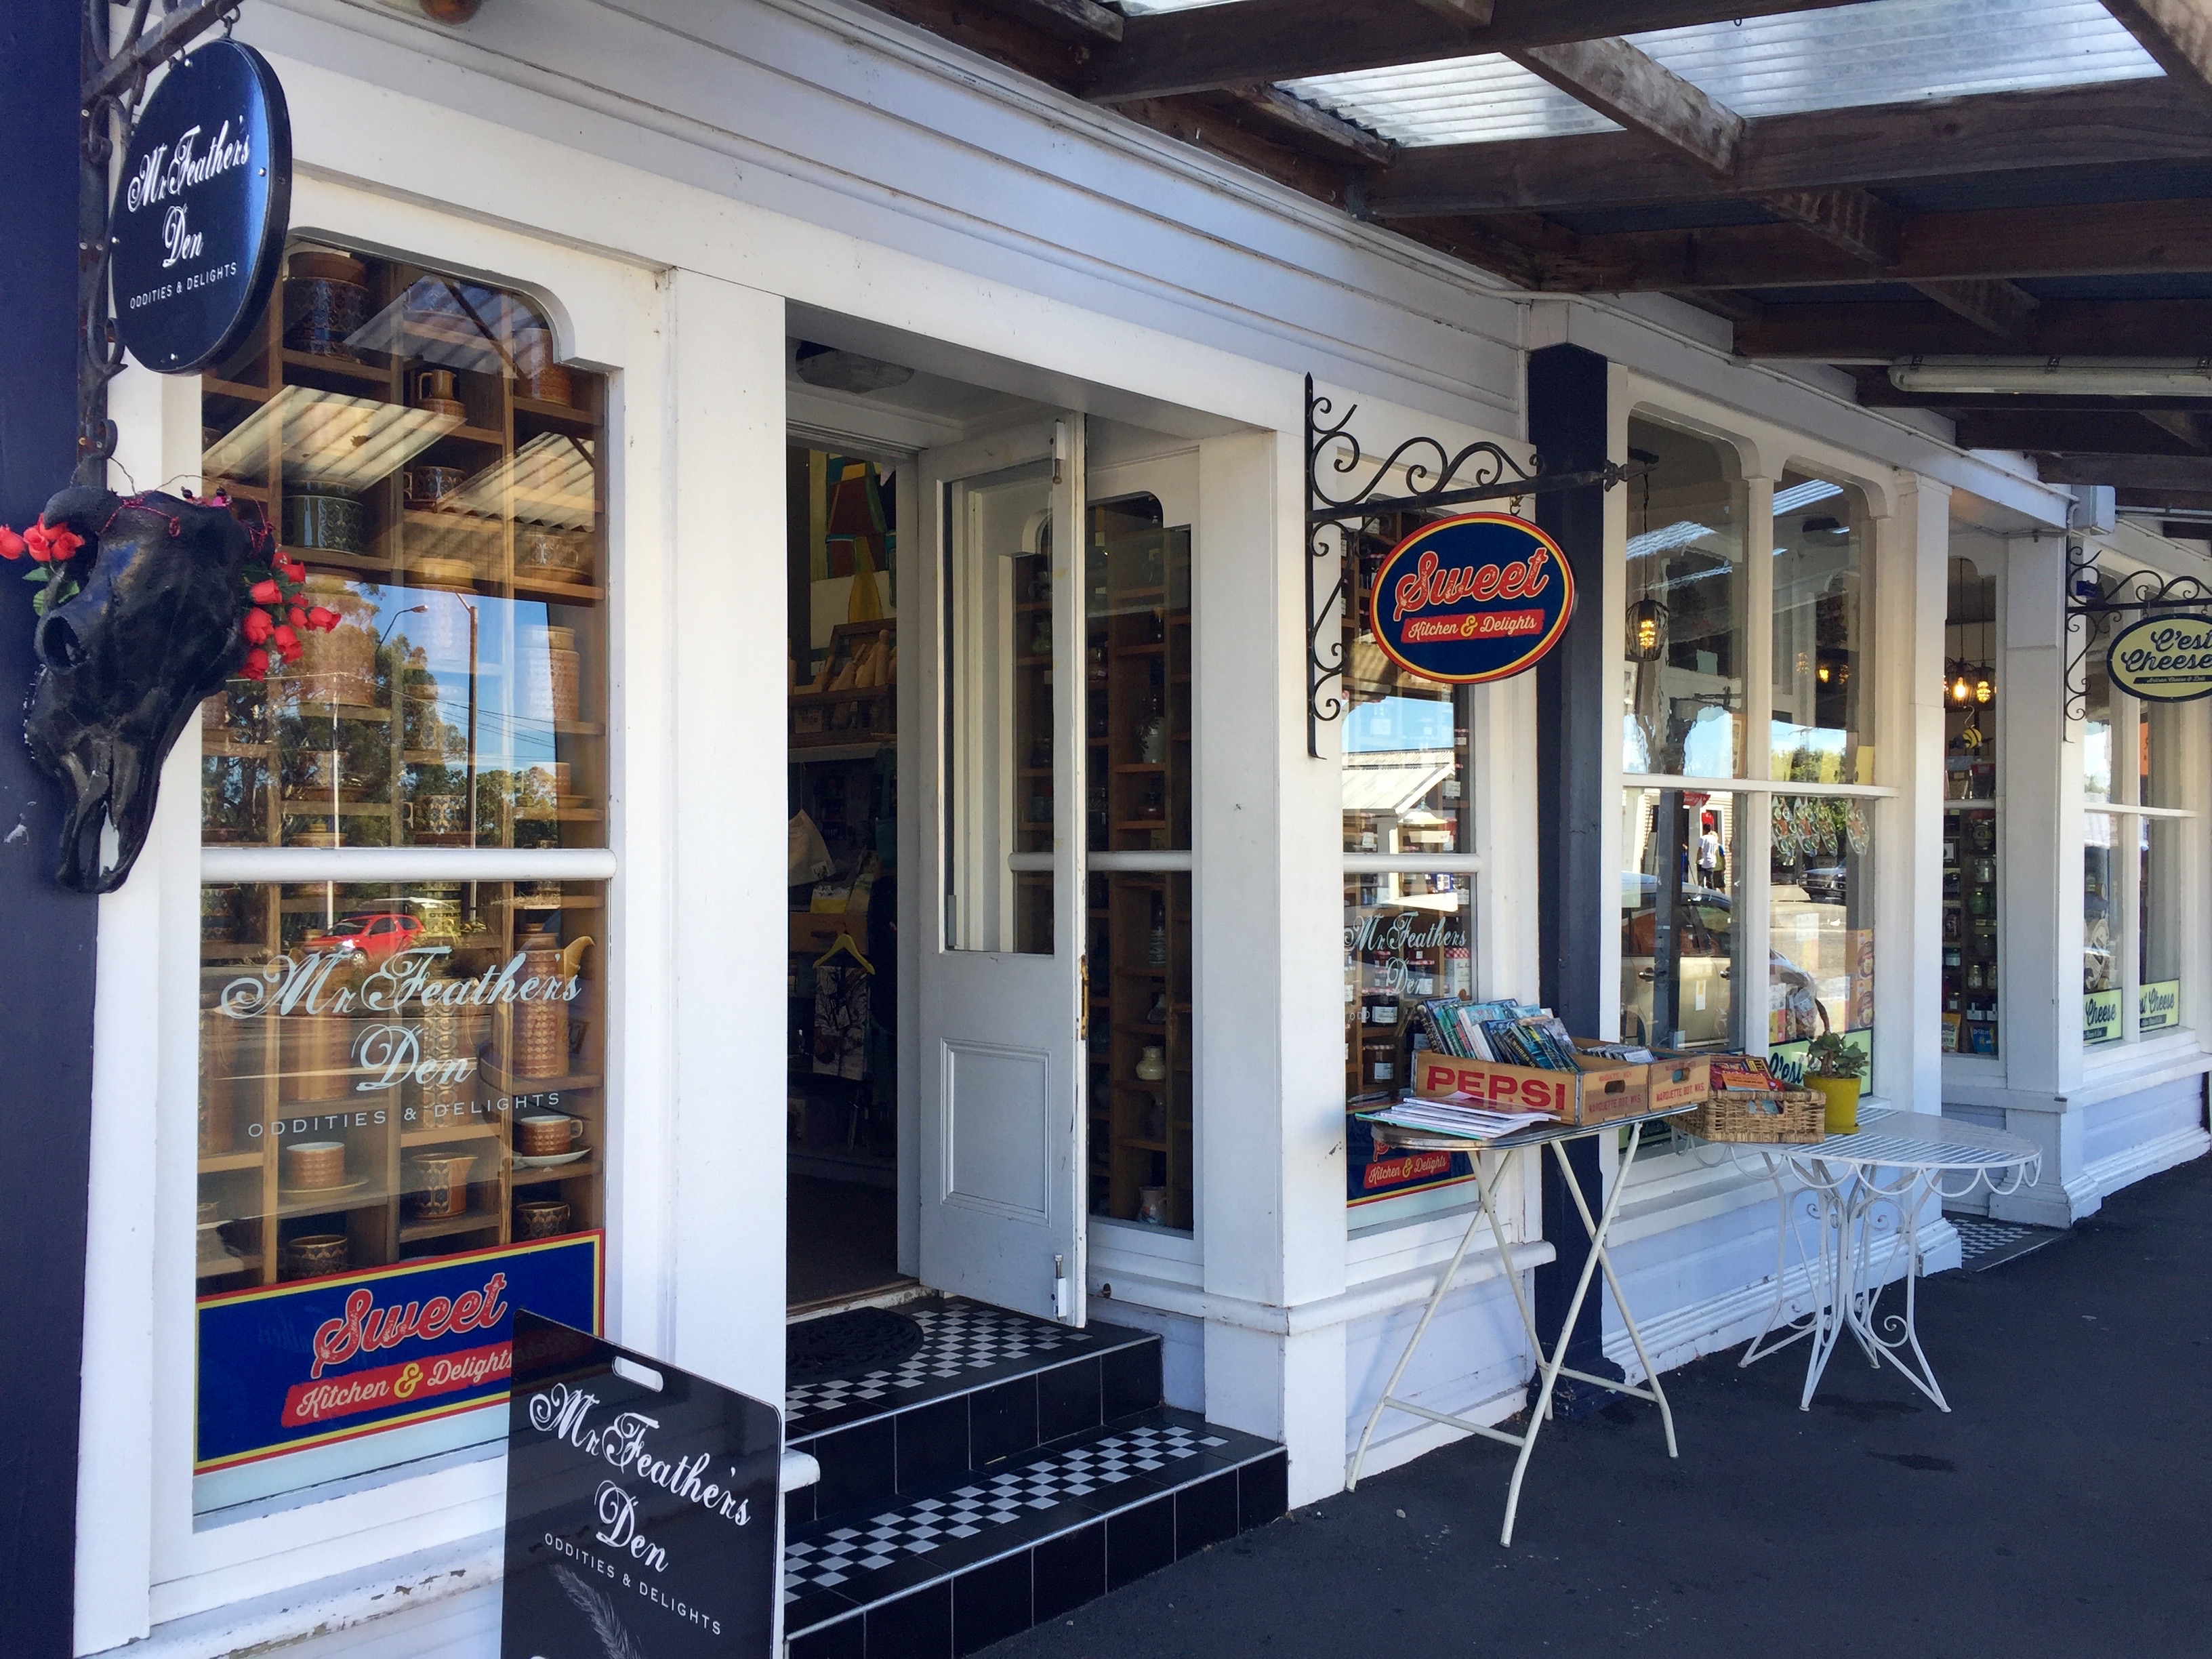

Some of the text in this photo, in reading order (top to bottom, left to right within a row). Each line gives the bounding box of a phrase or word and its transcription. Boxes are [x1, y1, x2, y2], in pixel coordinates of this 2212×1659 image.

[127, 115, 250, 213] Mr Feather's
[162, 205, 203, 268] Den
[129, 262, 237, 310] ODDITIES & DELIGHTS
[1393, 547, 1549, 621] Sweet
[1408, 615, 1537, 640] Kitchen & Delights
[2150, 628, 2212, 652] C'est
[2121, 649, 2212, 673] Cheese
[1344, 911, 1467, 951] Mr Feather's
[220, 945, 582, 1019] Mr Feather's
[2148, 987, 2175, 1014] Cheese
[2085, 998, 2116, 1027] Cheese
[351, 1024, 476, 1091] Den
[1427, 1065, 1565, 1110] PEPSI
[1656, 1088, 1682, 1102] MARQUETTE
[248, 1092, 561, 1138] ODDITIES & DELIGHTS
[1368, 1155, 1447, 1185] Kitchen & Delights
[311, 1273, 508, 1379] Sweet
[296, 1351, 512, 1419] Kitchen & Delights
[529, 1382, 751, 1526] Mr Feather's
[594, 1480, 669, 1573] Den
[544, 1532, 721, 1635] ODDITIES & DELIGHTS
